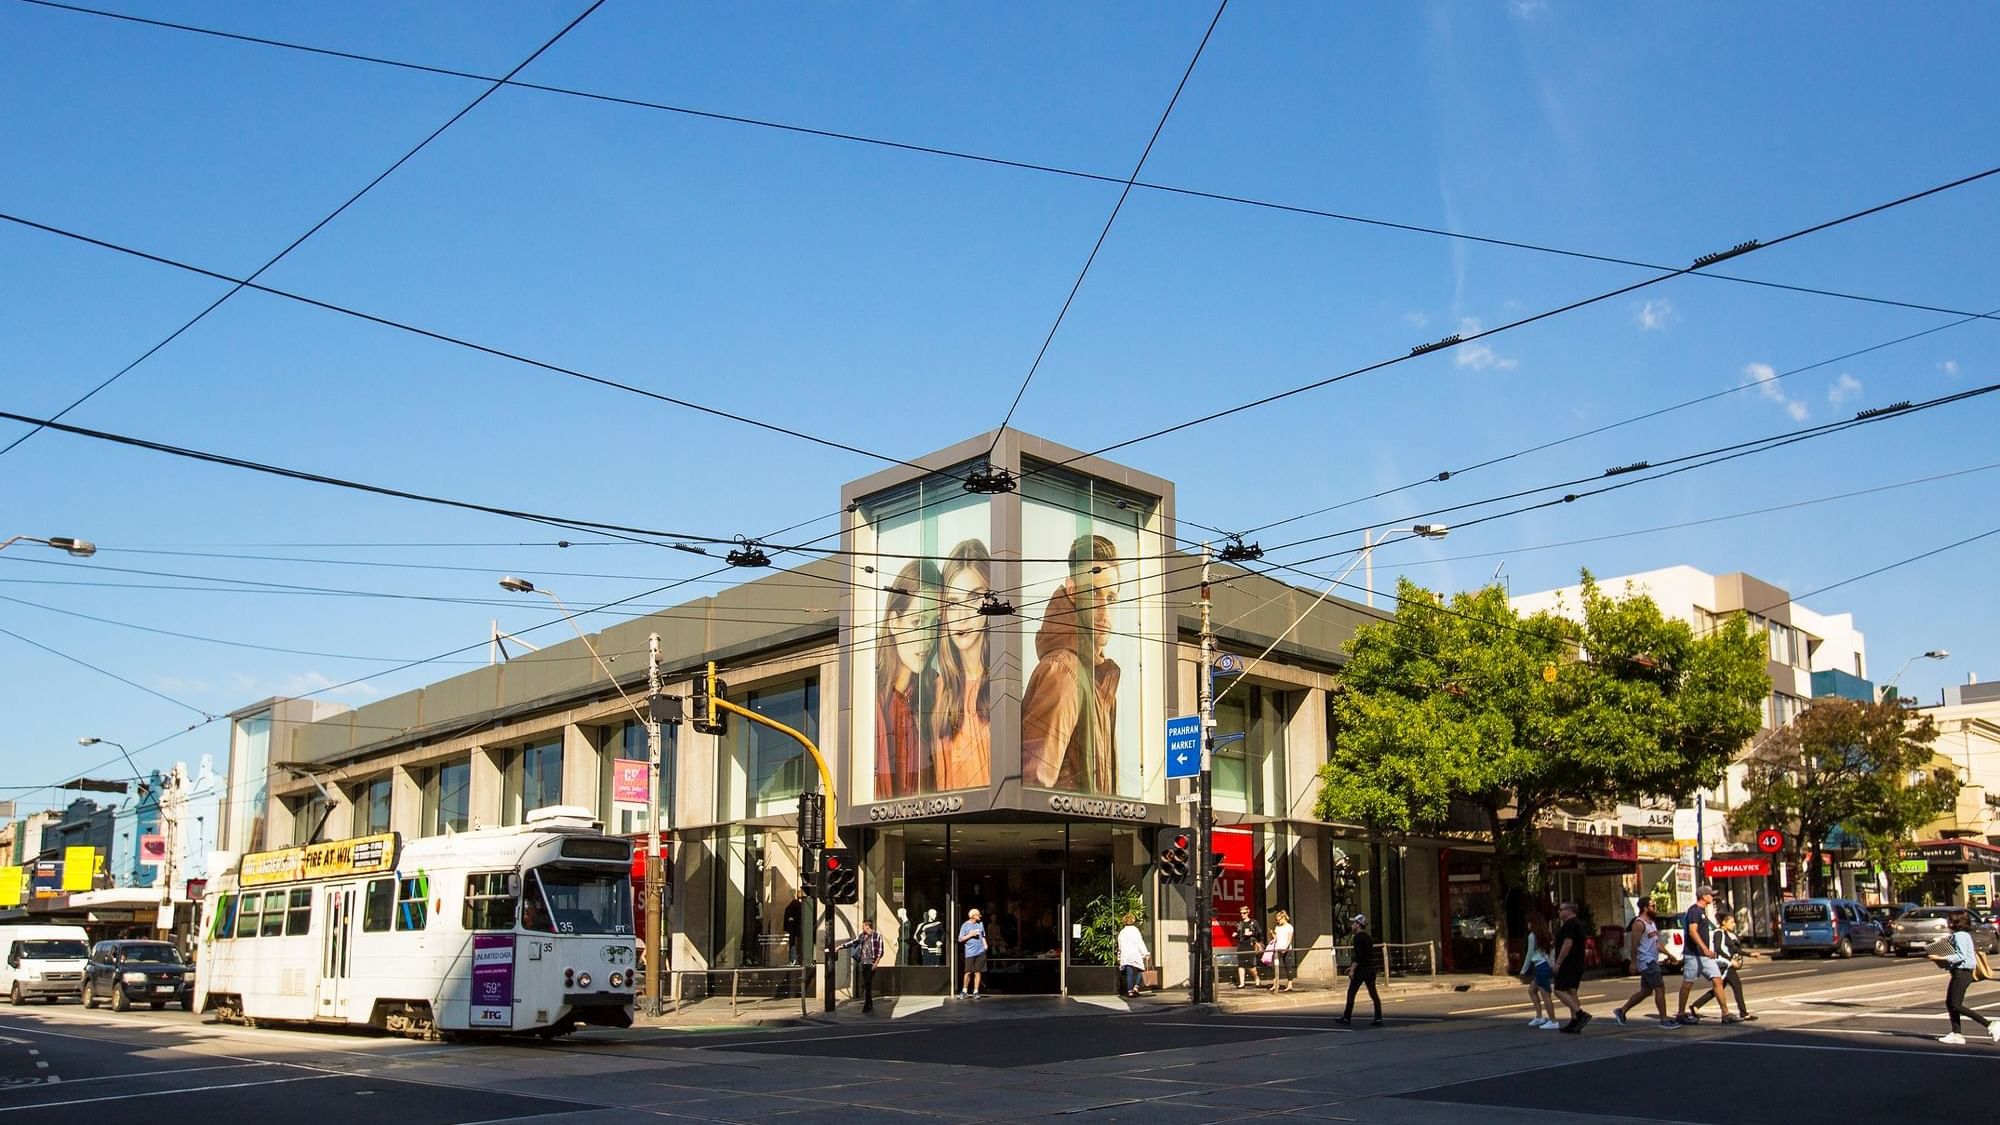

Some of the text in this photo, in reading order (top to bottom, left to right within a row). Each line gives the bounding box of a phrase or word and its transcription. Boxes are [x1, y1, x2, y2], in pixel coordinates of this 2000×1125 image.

[1168, 725, 1199, 737] PRAHRAN
[1171, 740, 1196, 751] MARKET
[870, 797, 963, 821] COUNTRY ROAD
[1050, 795, 1146, 819] COUNTRY ROAD
[1763, 836, 1778, 846] 40
[306, 850, 322, 868] FIRE
[323, 850, 335, 866] AT
[1211, 879, 1245, 902] ALE
[1789, 904, 1824, 913] PANOPLY
[560, 922, 574, 933] 35
[543, 943, 553, 953] 35
[482, 1010, 502, 1020] TPG
